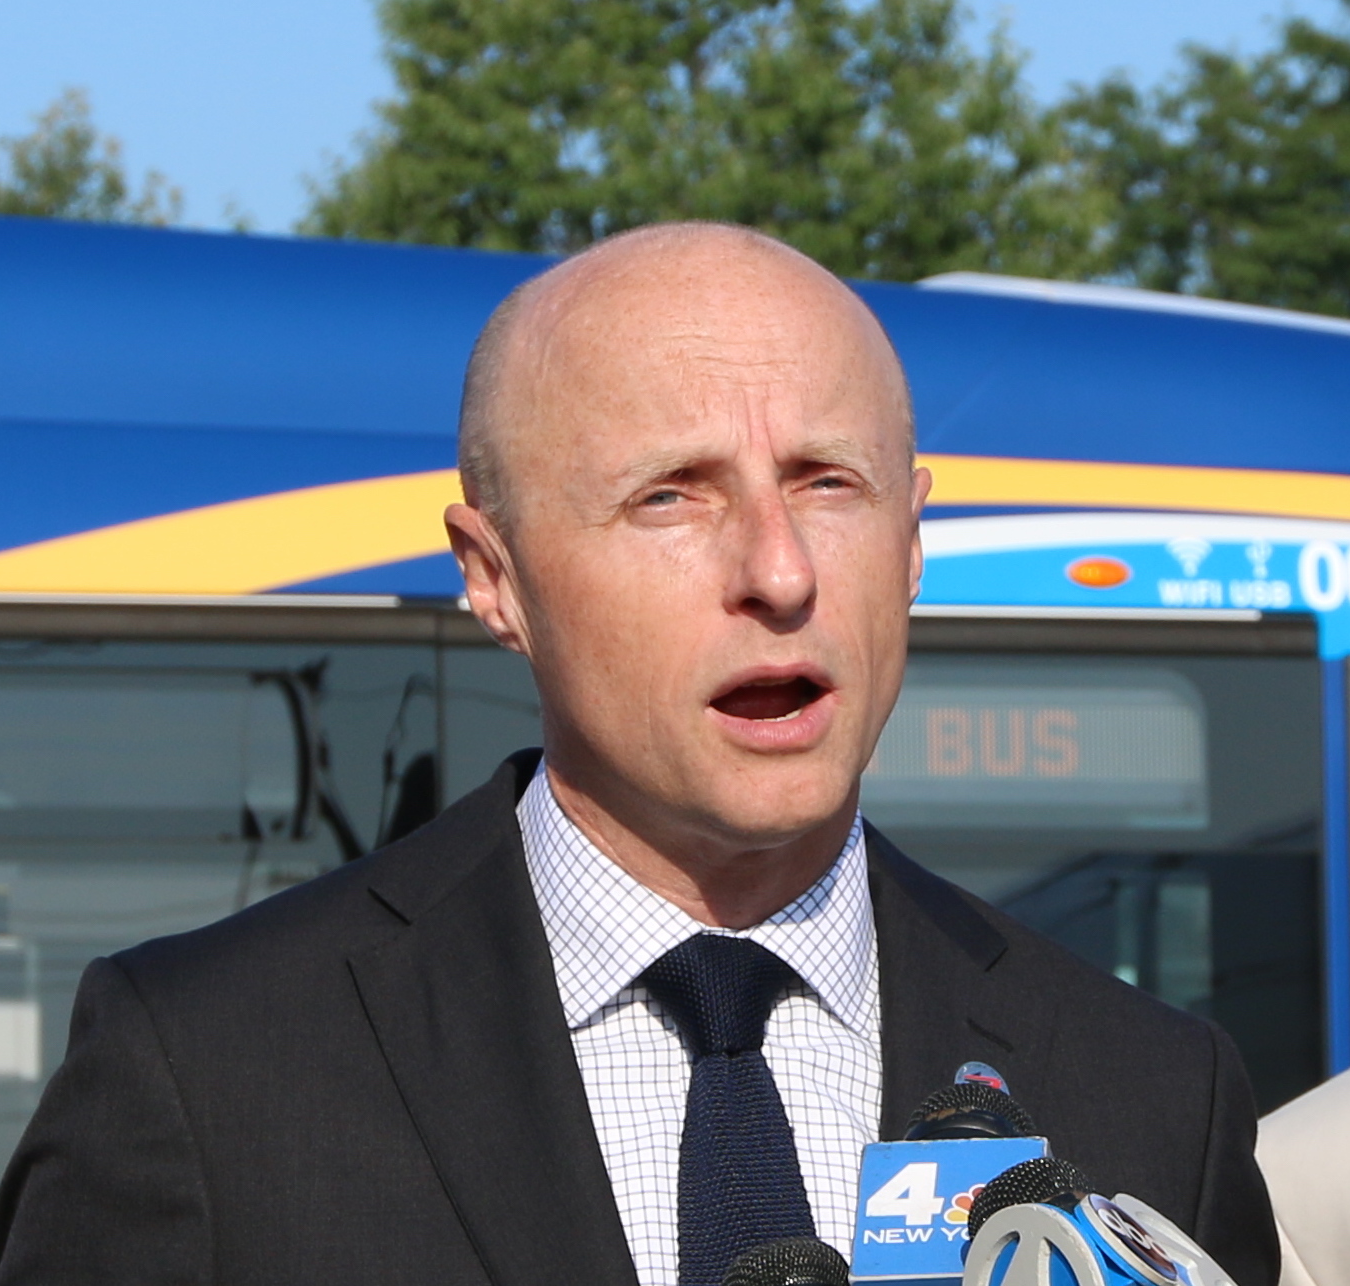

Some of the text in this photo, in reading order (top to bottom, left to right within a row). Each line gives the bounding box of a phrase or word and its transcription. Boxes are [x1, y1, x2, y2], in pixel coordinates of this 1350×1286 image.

[1229, 580, 1292, 608] USB
[924, 708, 1079, 777] BUS
[865, 1162, 945, 1226] 4
[863, 1228, 934, 1245] NEW
